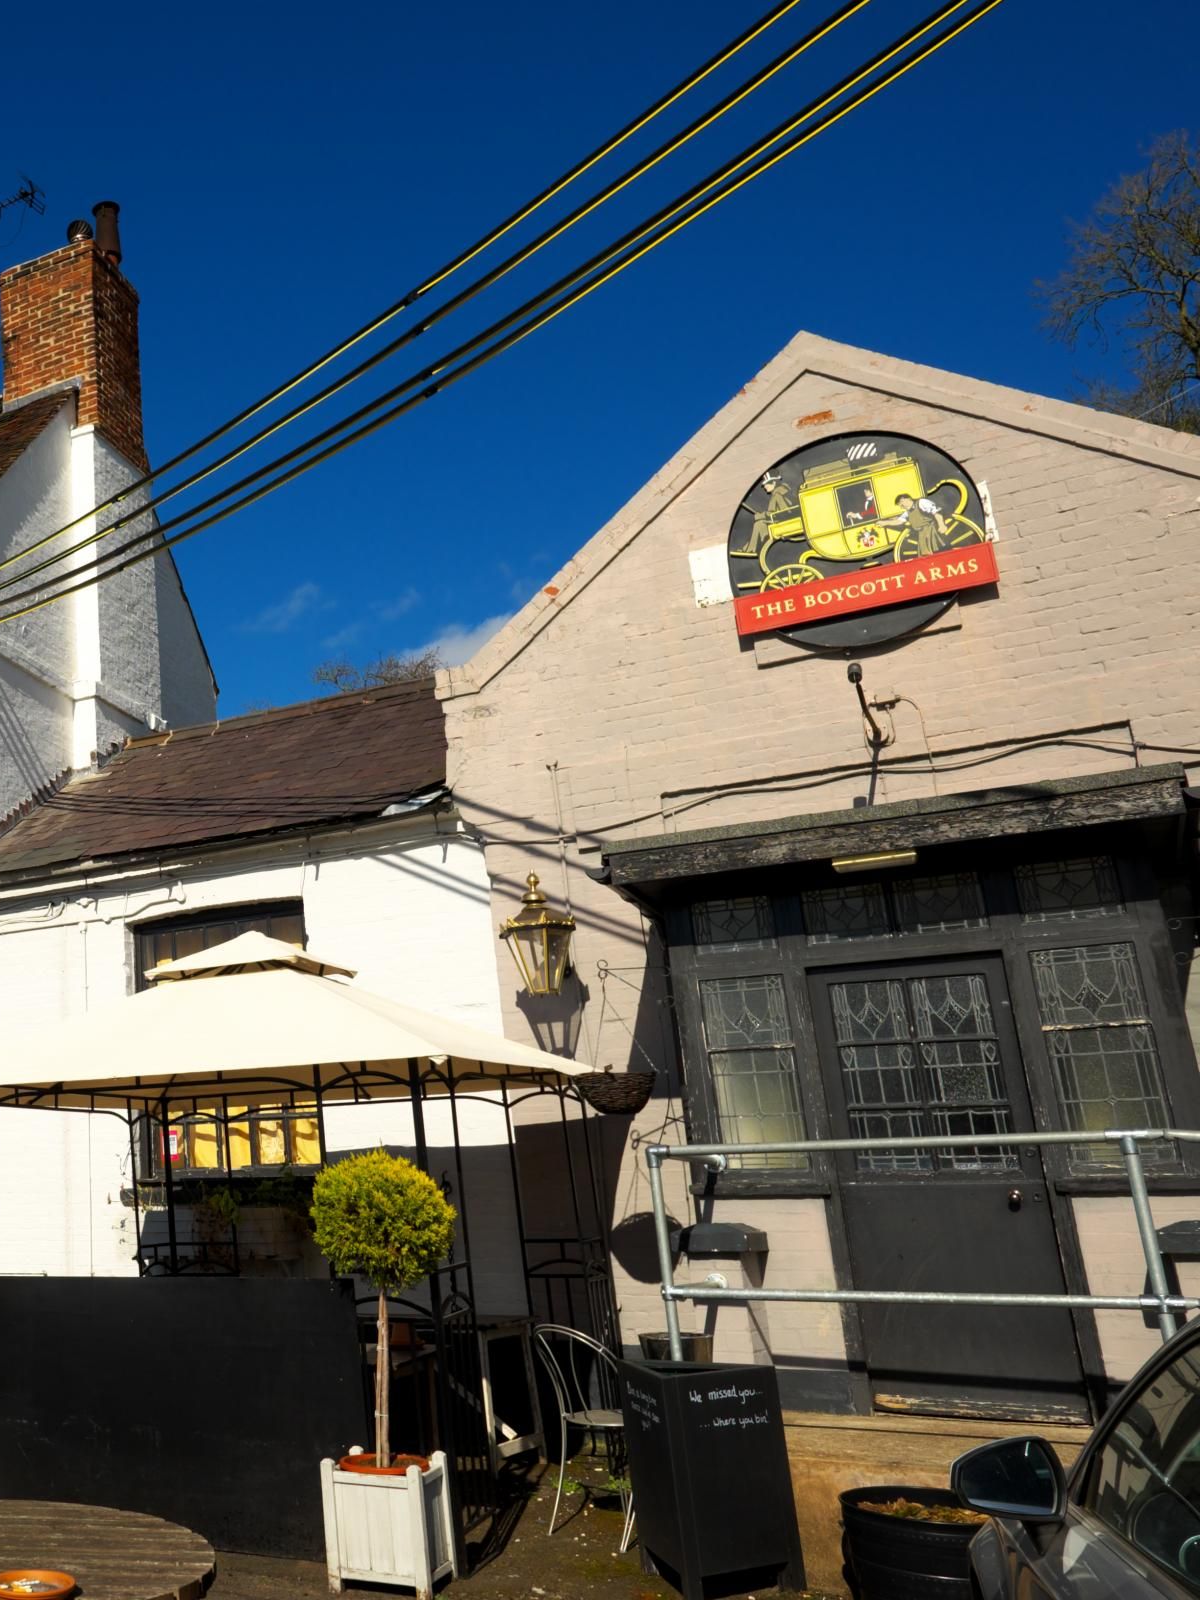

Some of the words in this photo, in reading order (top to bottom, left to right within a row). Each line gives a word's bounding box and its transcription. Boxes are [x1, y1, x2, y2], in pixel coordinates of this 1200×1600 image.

[751, 599, 797, 620] THE
[804, 574, 906, 609] BOYCOTT
[914, 558, 979, 585] ARMS
[689, 1389, 703, 1403] We
[708, 1384, 738, 1400] missed
[738, 1416, 754, 1429] you
